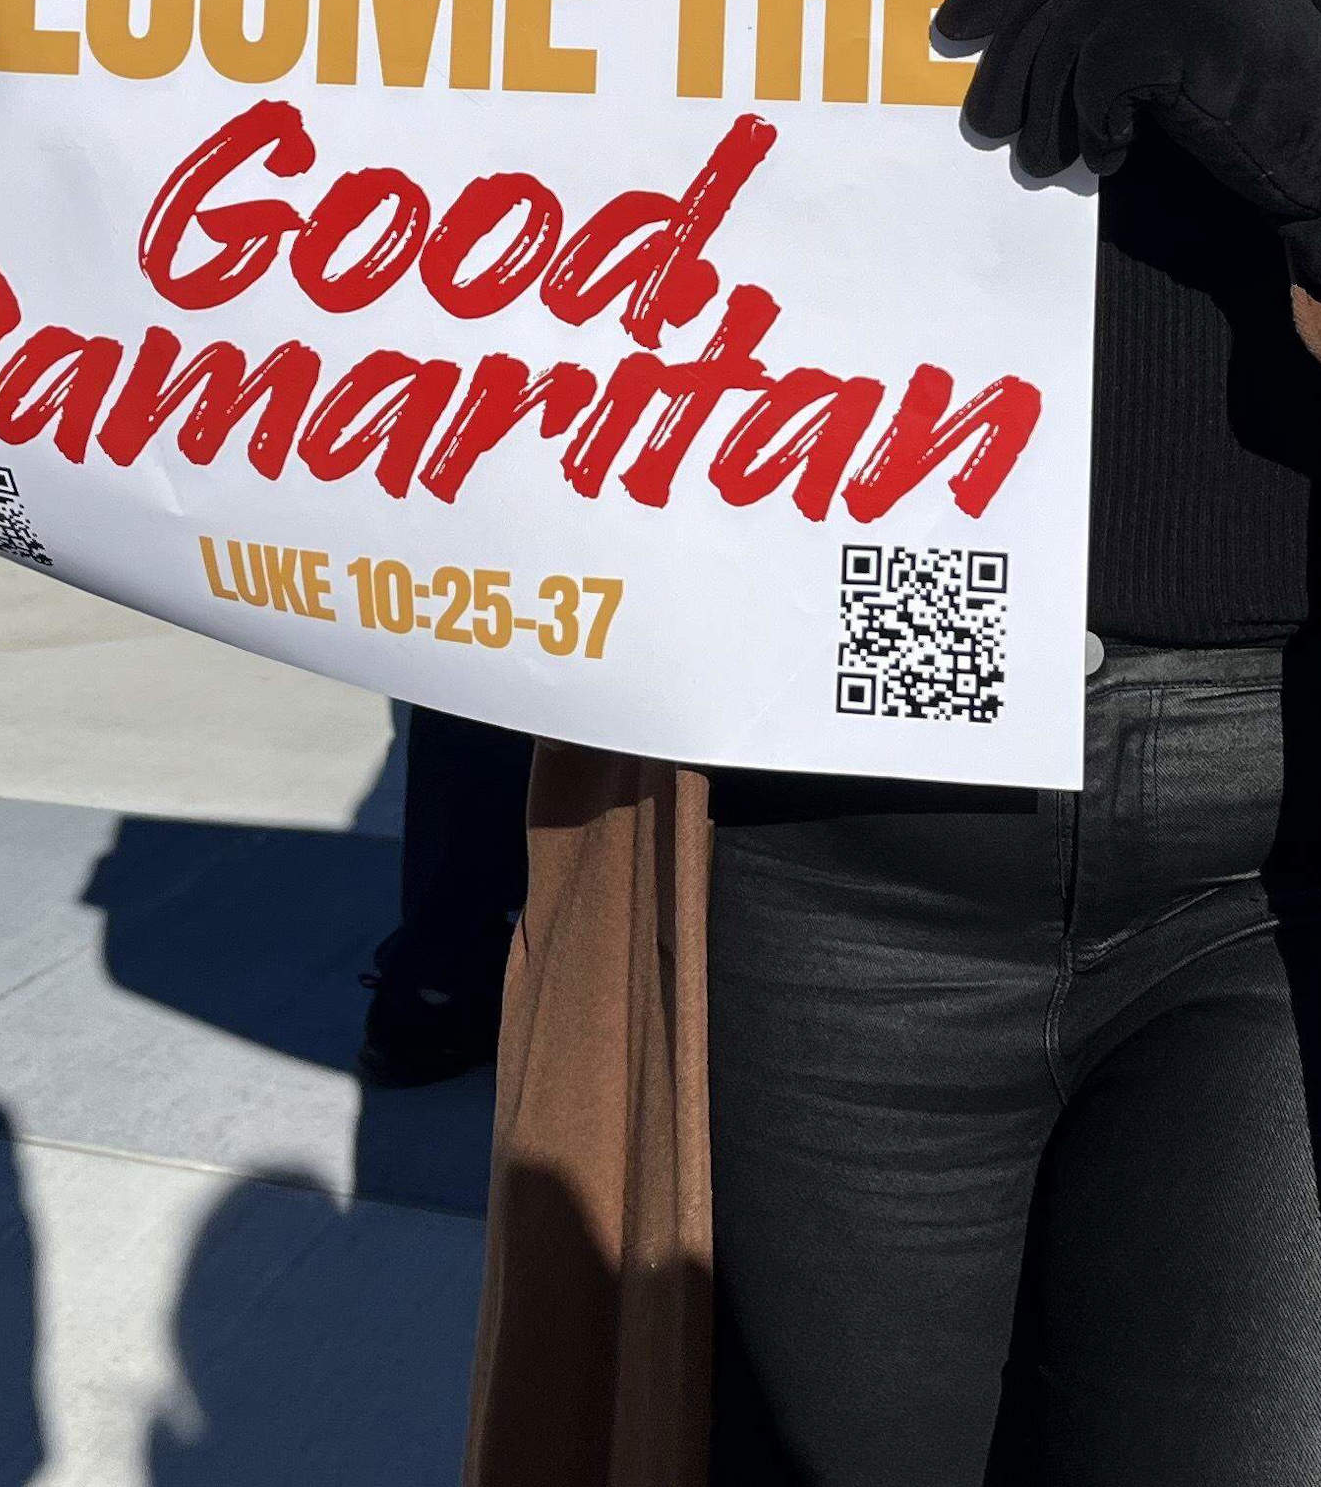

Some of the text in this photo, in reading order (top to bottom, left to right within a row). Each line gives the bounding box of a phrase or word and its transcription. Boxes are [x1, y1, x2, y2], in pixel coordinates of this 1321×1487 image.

[137, 99, 778, 349] Good
[199, 536, 624, 660] LUKE 10:25-37
